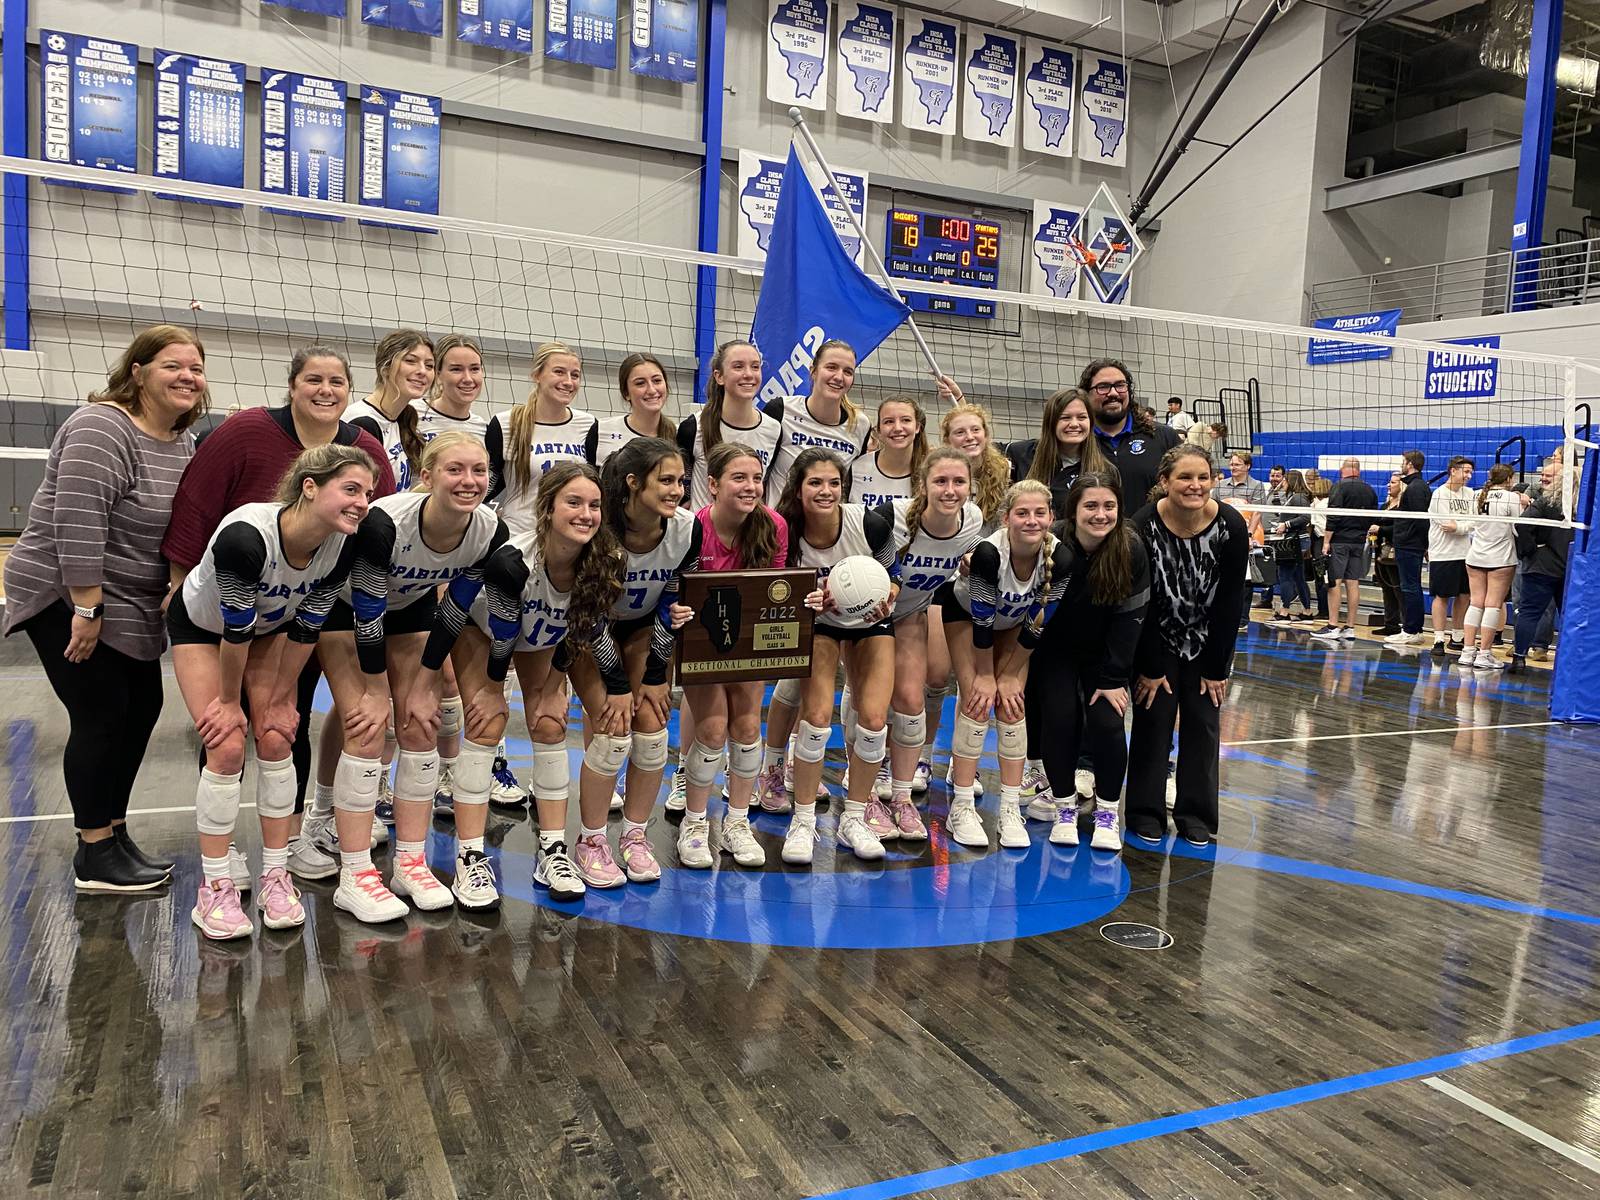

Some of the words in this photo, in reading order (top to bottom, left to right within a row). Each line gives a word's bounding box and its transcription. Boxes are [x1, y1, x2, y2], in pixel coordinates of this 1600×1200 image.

[792, 5, 811, 14] CLASS
[786, 10, 802, 20] BOYS
[804, 14, 824, 24] TRACK
[794, 20, 814, 30] STATE
[860, 20, 878, 30] CLASS
[786, 31, 796, 39] 3rd
[798, 34, 816, 44] PLACE
[852, 26, 870, 35] GIRLS
[871, 30, 890, 40] TRACK
[862, 36, 880, 44] STATE
[924, 36, 942, 44] CLASS
[864, 50, 884, 58] PLACE
[919, 41, 932, 50] BOYS
[934, 45, 952, 54] TRACK
[927, 50, 944, 58] STATE
[984, 50, 1001, 58] CLASS
[980, 55, 1013, 68] VOLLEYBALL
[988, 64, 1005, 72] STATE
[1042, 62, 1058, 70] CLASS
[121, 78, 132, 86] 10
[1098, 74, 1114, 82] CLASS
[158, 81, 180, 118] FIELD
[1104, 100, 1118, 108] PLACE
[45, 64, 70, 162] SOCCER
[264, 100, 286, 135] FIELD
[79, 128, 91, 136] 10
[158, 120, 180, 131] &
[264, 138, 286, 148] &
[158, 132, 179, 174] TRACK
[363, 112, 384, 200] WRESTLING
[264, 148, 285, 188] TRACK
[756, 182, 772, 191] BOYS
[760, 176, 780, 186] CLASS
[848, 184, 858, 192] 3A
[942, 219, 970, 241] 1:00
[904, 226, 918, 248] 18
[977, 236, 998, 258] 25
[936, 251, 956, 262] period
[962, 250, 970, 266] 0
[894, 260, 909, 271] fouls
[934, 267, 955, 278] player
[979, 272, 994, 282] fouls
[934, 300, 950, 308] game
[978, 304, 991, 314] won
[1333, 316, 1380, 328] ATHLETICO
[1428, 368, 1494, 394] STUDENTS
[792, 432, 856, 456] SPARTANS
[906, 574, 946, 591] 20
[627, 588, 648, 610] 7
[760, 606, 796, 620] 2022
[846, 599, 874, 614] Wilson
[525, 618, 568, 646] 17
[762, 632, 791, 641] VOLLEYBALL
[688, 660, 742, 672] SECTIONAL
[750, 656, 806, 668] CHAMPIONS
